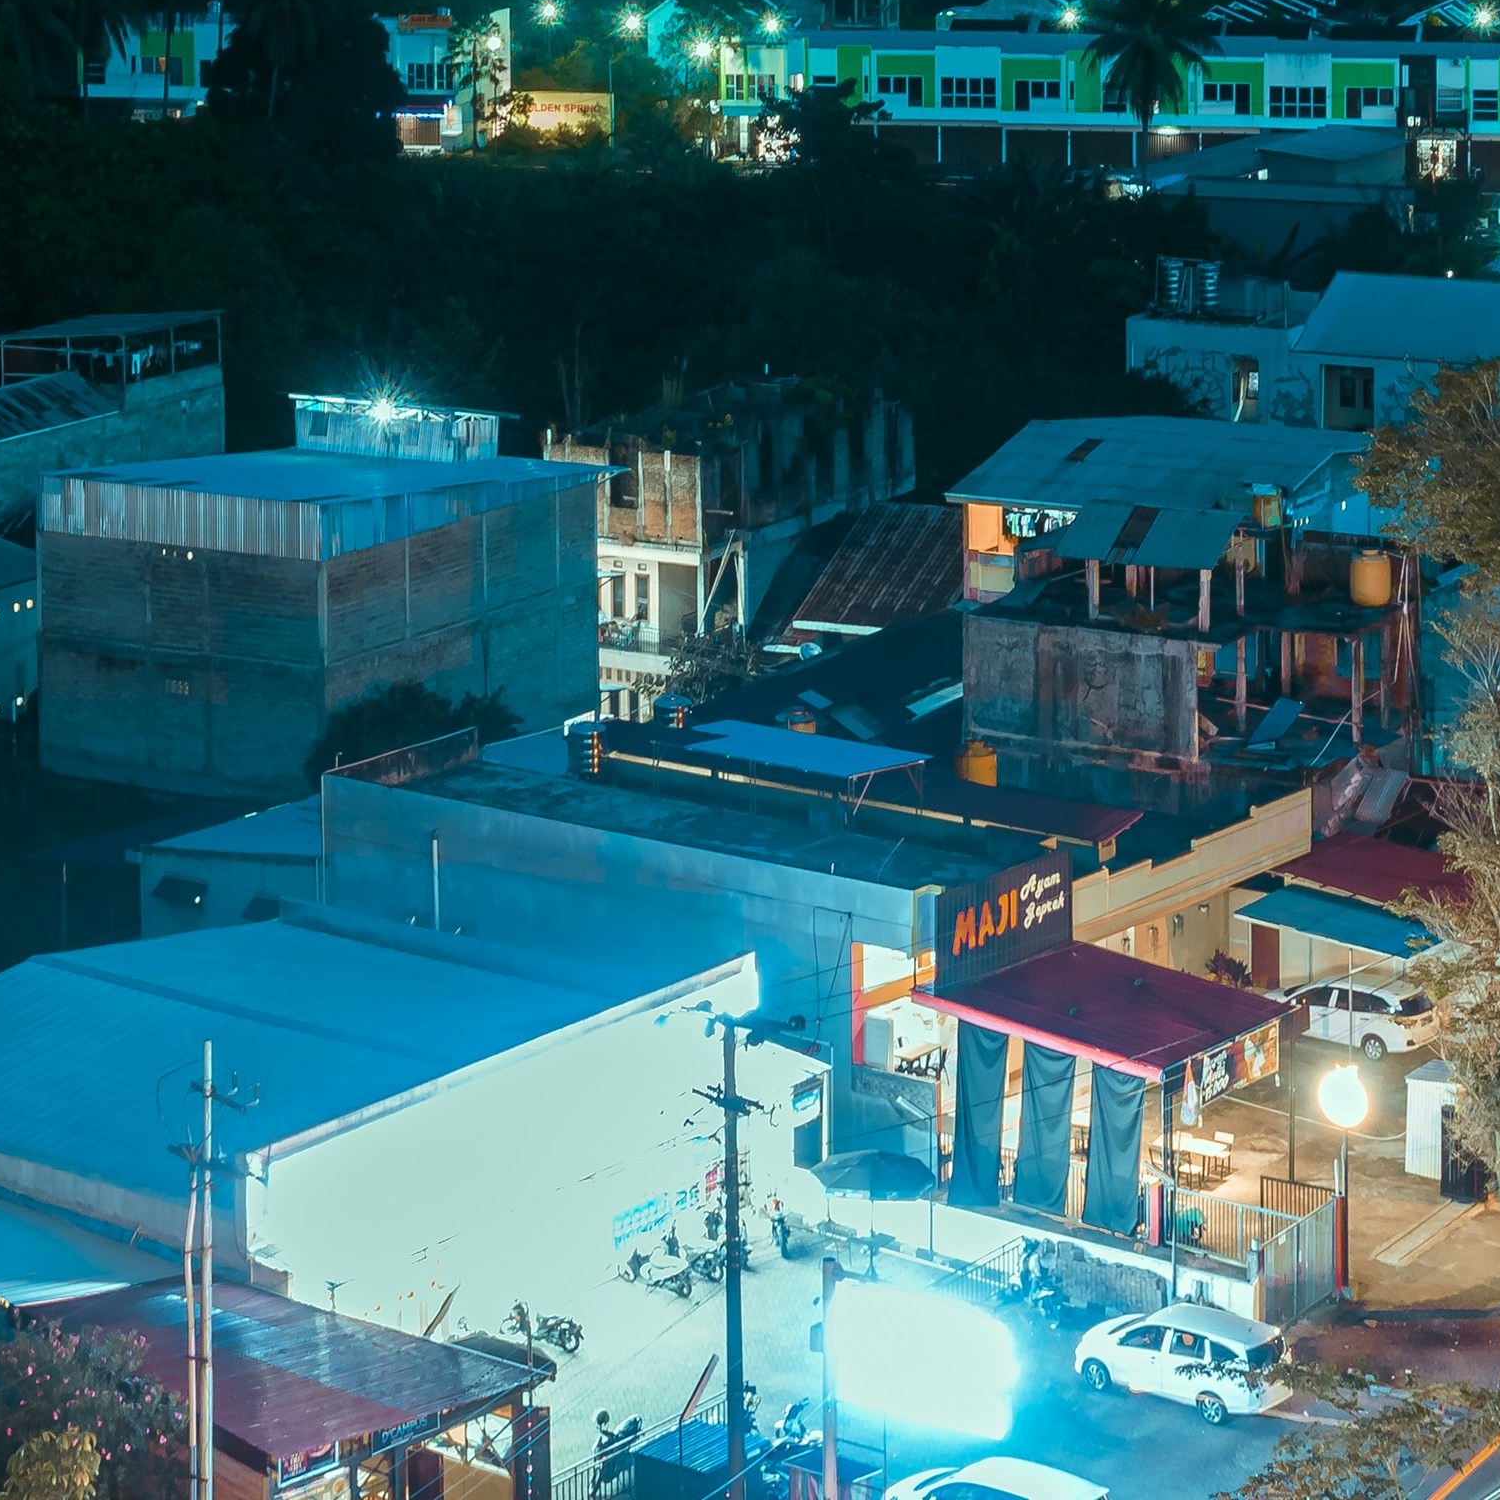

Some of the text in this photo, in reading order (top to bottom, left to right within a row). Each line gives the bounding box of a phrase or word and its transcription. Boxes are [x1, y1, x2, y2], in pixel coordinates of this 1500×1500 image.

[1020, 872, 1061, 901] Ayam
[952, 889, 1018, 956] MAJI
[1023, 890, 1065, 930] Geprek
